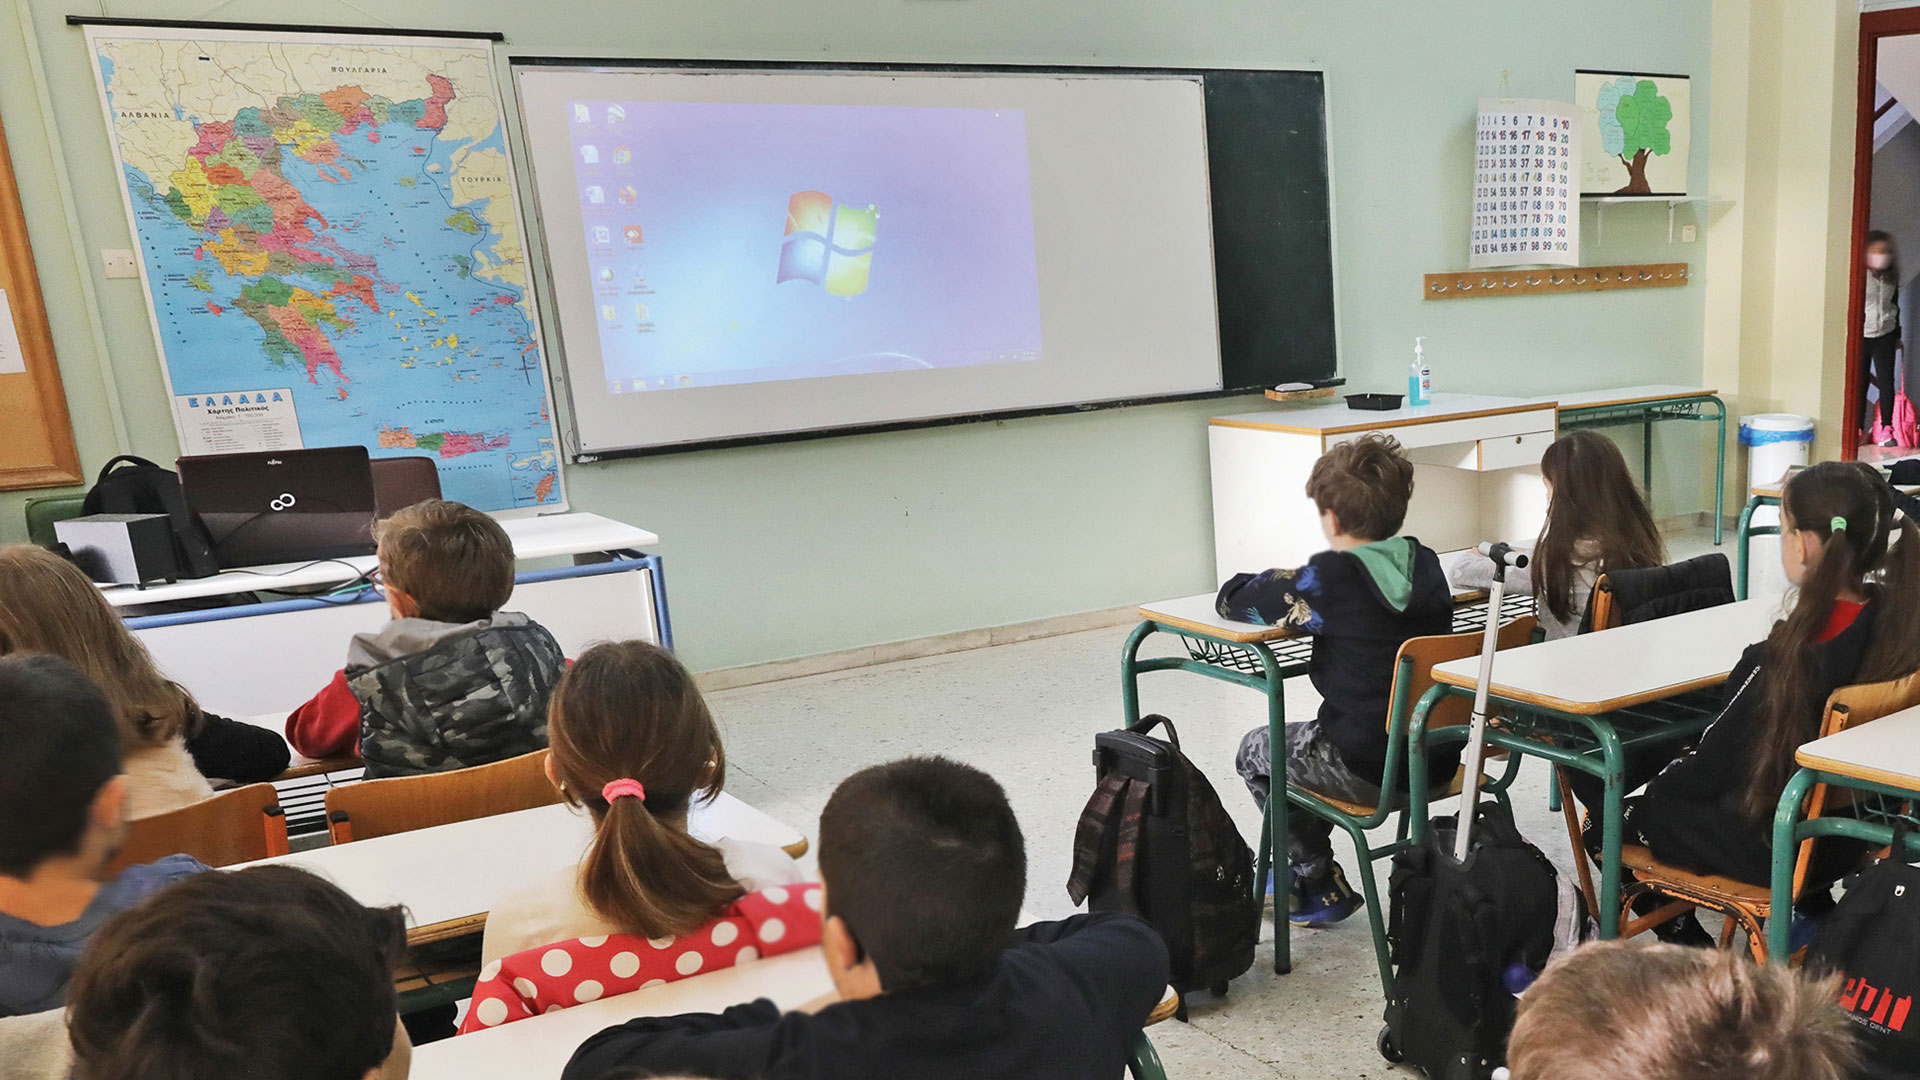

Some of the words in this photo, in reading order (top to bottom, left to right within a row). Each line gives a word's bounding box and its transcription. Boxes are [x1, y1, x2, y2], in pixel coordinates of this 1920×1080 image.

[331, 66, 387, 74] ΒΟΥΛΓΑΡΙΑ
[121, 111, 170, 119] ΑΛΒΑΝΙΑ
[1502, 115, 1506, 126] 5
[1512, 115, 1518, 126] 6
[1527, 115, 1532, 126] 7
[1540, 116, 1545, 126] 8
[1552, 118, 1558, 128] 9
[1561, 120, 1570, 130] 10
[1499, 130, 1506, 140] 15
[1509, 130, 1518, 140] 16
[1521, 130, 1531, 140] 17
[1536, 130, 1545, 141] 18
[1548, 131, 1557, 142] 19
[1560, 134, 1569, 144] 20
[1500, 144, 1506, 155] 25
[1509, 144, 1518, 155] 26
[1520, 144, 1530, 155] 27
[1534, 144, 1544, 155] 28
[1547, 146, 1556, 156] 29
[1560, 146, 1568, 158] 30
[1500, 158, 1506, 169] 35
[1509, 158, 1518, 168] 36
[1520, 158, 1530, 168] 37
[1534, 158, 1544, 168] 38
[1546, 159, 1556, 169] 39
[1560, 160, 1568, 171] 40
[1499, 172, 1506, 182] 45
[1509, 172, 1518, 182] 46
[1520, 172, 1530, 182] 47
[1532, 172, 1542, 182] 48
[1546, 172, 1556, 183] 49
[1560, 174, 1568, 184] 50
[1500, 186, 1507, 197] 55
[1510, 186, 1518, 197] 56
[1520, 186, 1528, 196] 57
[1532, 186, 1542, 196] 58
[1546, 186, 1556, 197] 59
[1558, 188, 1568, 198] 60
[1500, 200, 1507, 212] 65
[1510, 200, 1518, 211] 66
[1520, 200, 1528, 210] 67
[1532, 200, 1542, 210] 68
[1544, 200, 1554, 210] 69
[1558, 200, 1567, 212] 70
[1500, 214, 1508, 225] 75
[1510, 214, 1518, 224] 76
[1520, 213, 1528, 224] 77
[1532, 213, 1541, 224] 78
[1544, 213, 1554, 224] 79
[1558, 214, 1566, 224] 80
[1500, 228, 1507, 239] 85
[1510, 228, 1518, 238] 86
[1520, 227, 1528, 238] 87
[1530, 227, 1540, 238] 88
[1543, 226, 1553, 238] 89
[1556, 228, 1566, 238] 90
[1500, 242, 1508, 252] 95
[1510, 242, 1518, 252] 96
[1520, 241, 1528, 252] 97
[1530, 241, 1540, 252] 98
[1542, 240, 1552, 251] 99
[1555, 241, 1568, 252] 100
[188, 391, 283, 408] ΕΛΛΑΔΑ
